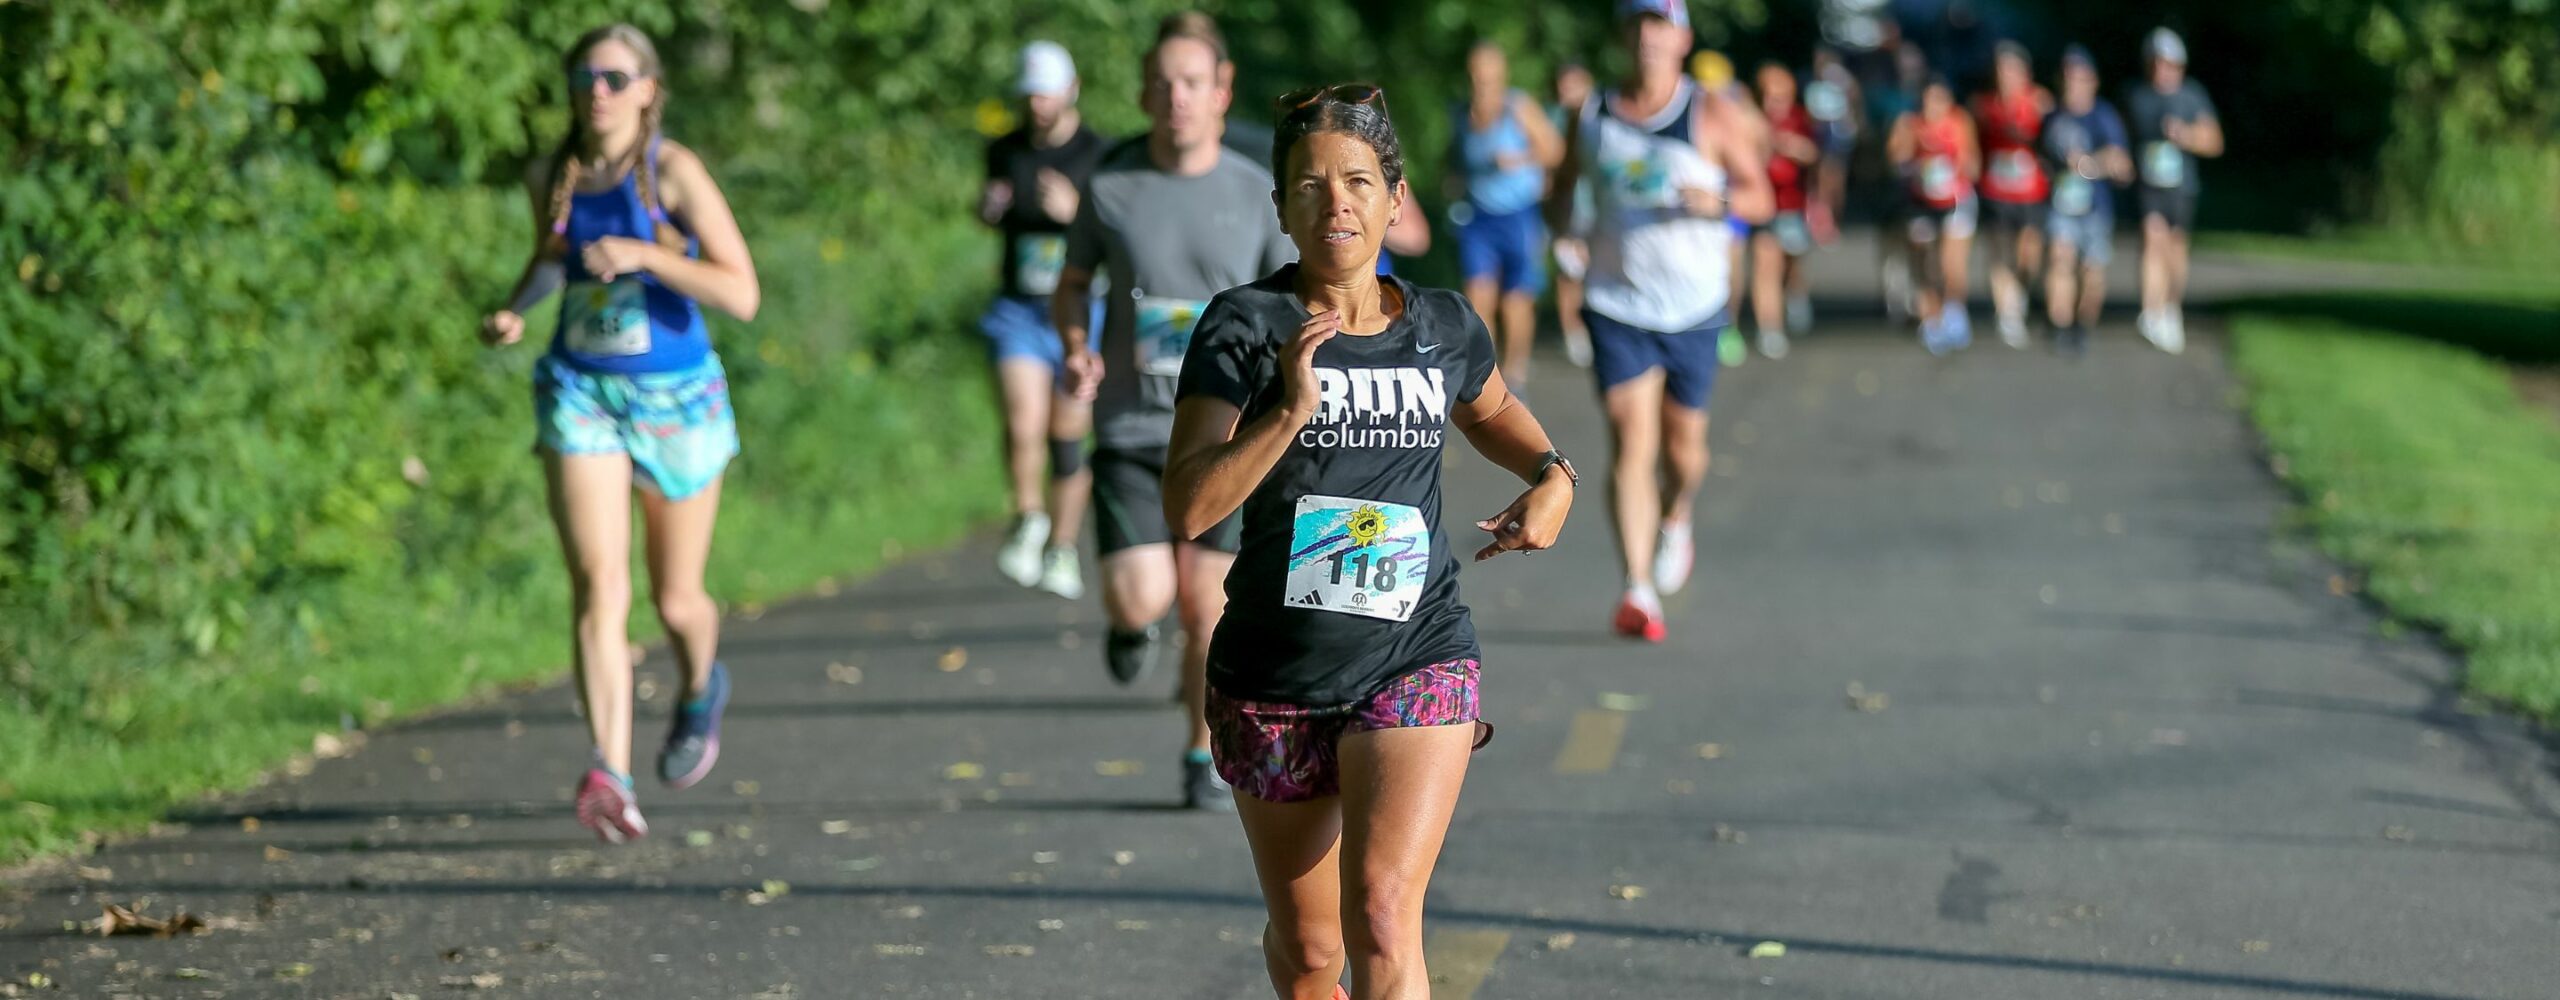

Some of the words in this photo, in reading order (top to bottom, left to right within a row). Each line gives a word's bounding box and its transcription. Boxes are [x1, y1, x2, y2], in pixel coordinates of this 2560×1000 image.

[1312, 366, 1447, 424] RUN
[1299, 421, 1442, 449] columbus
[1327, 550, 1398, 592] 118
